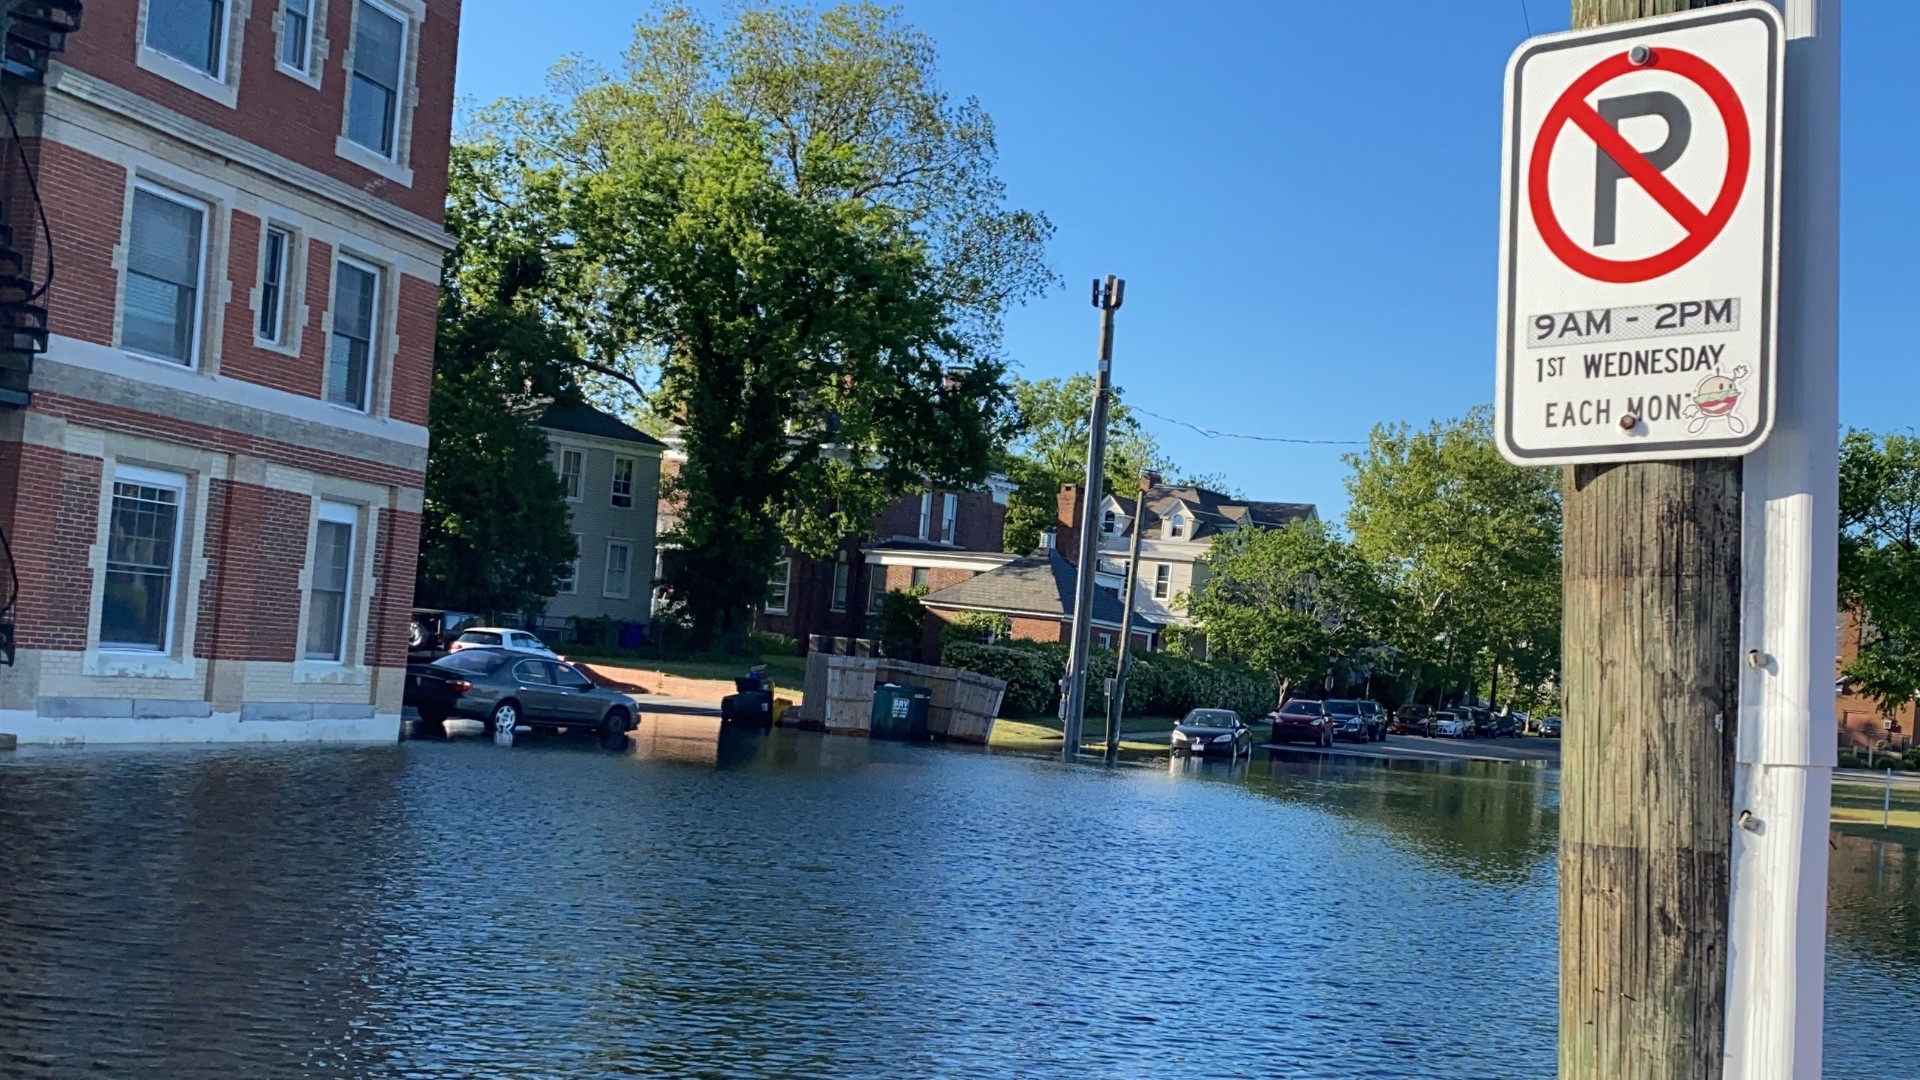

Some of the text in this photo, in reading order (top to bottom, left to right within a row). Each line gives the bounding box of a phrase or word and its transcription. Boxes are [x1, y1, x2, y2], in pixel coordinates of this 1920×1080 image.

[1593, 90, 1692, 247] P
[1535, 298, 1732, 340] 9AM - 2PM
[1536, 344, 1725, 383] 1ST WEDNESDAY
[1545, 393, 1692, 428] EACH MON
